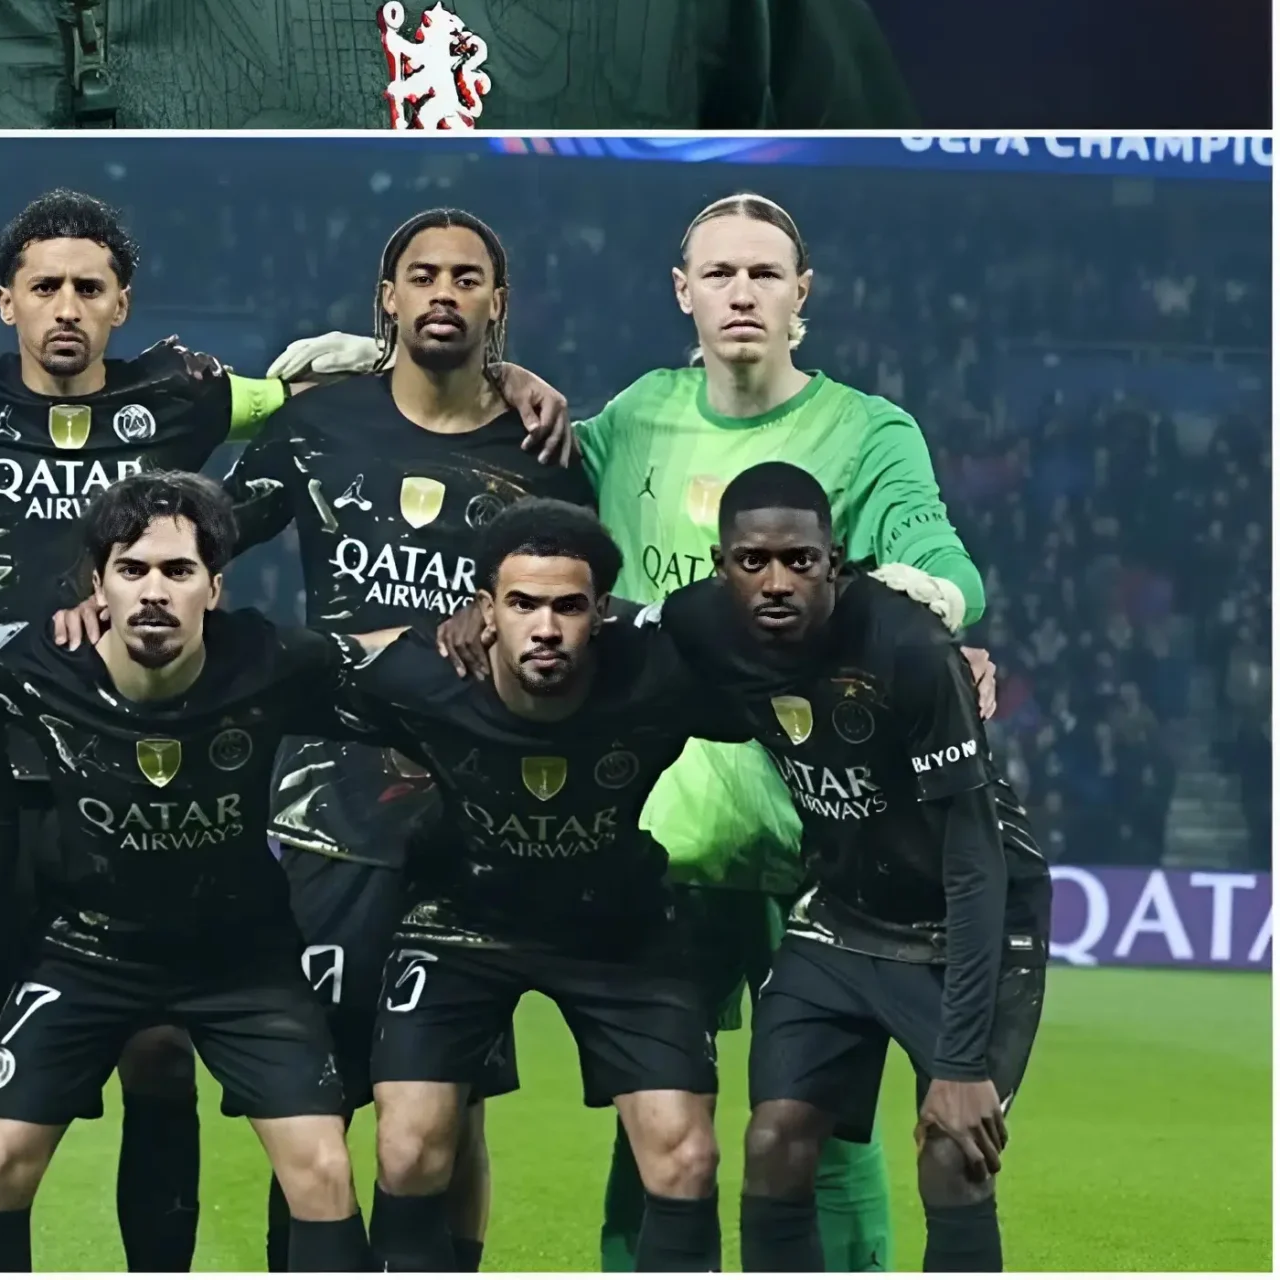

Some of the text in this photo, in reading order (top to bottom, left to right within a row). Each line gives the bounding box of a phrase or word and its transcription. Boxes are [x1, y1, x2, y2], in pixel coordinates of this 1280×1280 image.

[336, 538, 476, 593] QATAR
[643, 545, 718, 589] QAT
[78, 793, 242, 835] QATAR
[462, 804, 618, 842] QATAR
